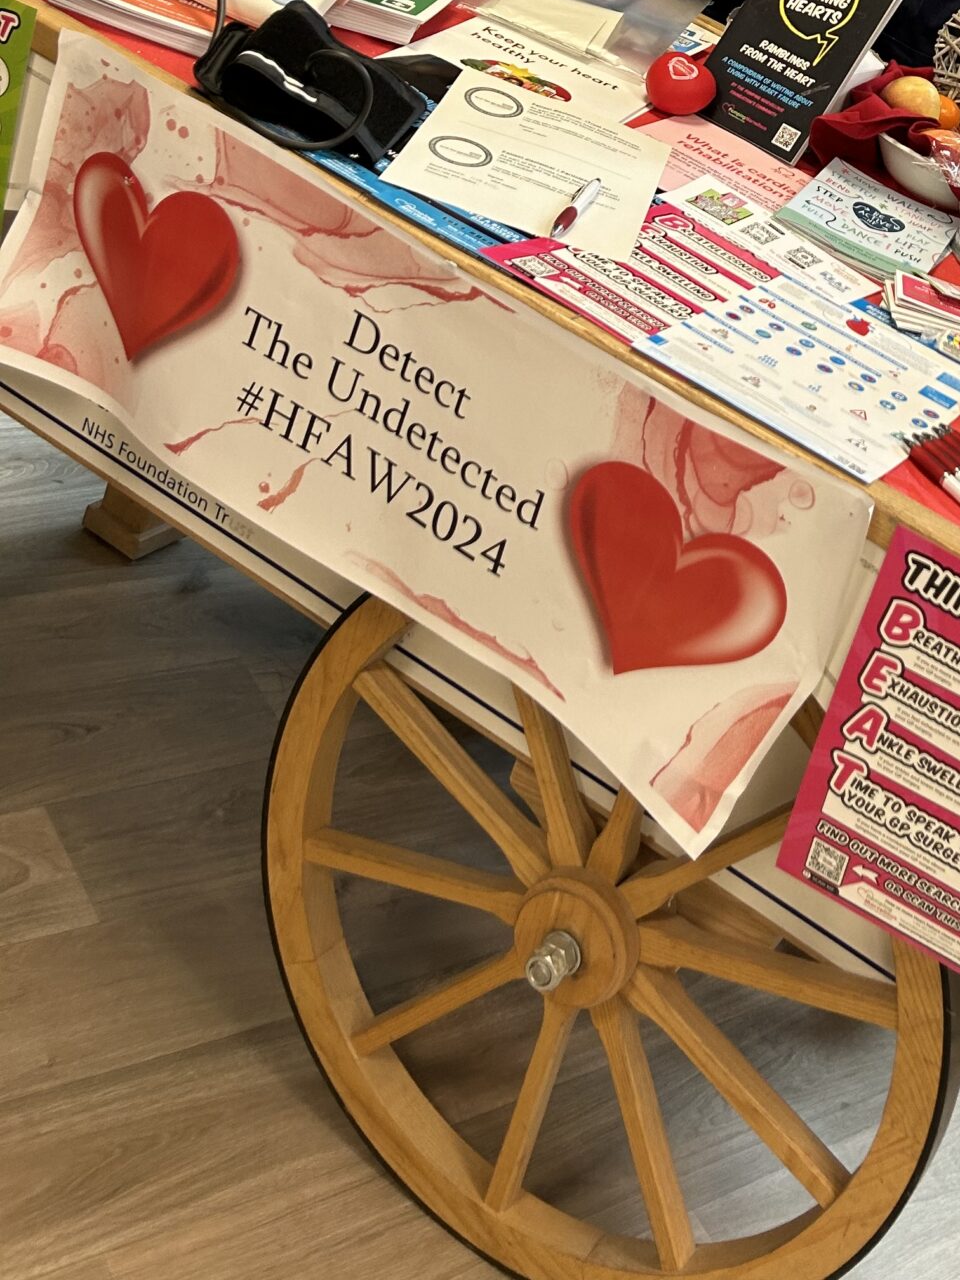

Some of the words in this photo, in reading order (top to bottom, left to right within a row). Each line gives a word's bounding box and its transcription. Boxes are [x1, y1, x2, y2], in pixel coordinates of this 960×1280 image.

[469, 29, 537, 67] healthy
[480, 23, 527, 53] Keep
[527, 47, 571, 71] your
[569, 65, 620, 92] heart
[738, 43, 768, 64] FROM
[765, 58, 786, 75] THE
[784, 66, 816, 89] HEART
[758, 38, 812, 72] RAMBLINGS
[720, 54, 729, 63] A
[726, 57, 764, 82] COMPENDIUM
[762, 75, 773, 85] OF
[770, 79, 796, 98] WRITING
[793, 91, 814, 108] ABOUT
[725, 66, 746, 81] LIVING
[743, 74, 761, 88] WITH
[758, 82, 778, 97] HEART
[776, 91, 801, 109] FAILURE
[675, 137, 794, 203] rehabilitation?
[684, 131, 730, 159] What
[731, 156, 745, 168] is
[746, 166, 799, 197] cardia
[829, 170, 878, 201] STRETCH
[800, 202, 826, 220] PULL
[810, 193, 850, 218] MOVE
[814, 184, 845, 204] STEP
[853, 175, 881, 194] MOVE
[885, 192, 926, 215] WALK
[657, 210, 770, 283] BREATHLESSNESS
[839, 221, 884, 248] DANCE
[893, 235, 930, 256] LIFT
[893, 247, 922, 264] PUSH
[905, 232, 930, 247] PLAY
[577, 252, 611, 276] YOUR
[612, 273, 629, 287] GP
[631, 284, 690, 322] SURGERY
[612, 264, 629, 278] TO
[634, 278, 668, 303] SPEAK
[673, 302, 689, 315] TO
[655, 263, 714, 302] SWELLING
[336, 307, 481, 421] Detect
[229, 305, 325, 384] The
[314, 355, 556, 533] Undetected
[78, 416, 119, 452] NHS
[114, 440, 213, 513] Foundation
[228, 375, 520, 580] #HFAW2024
[842, 701, 915, 763] ANKLE
[822, 751, 883, 802] TIME
[881, 794, 904, 814] TO
[903, 808, 956, 845] SPEAK
[843, 789, 886, 822] YOUR
[886, 815, 912, 836] GP
[817, 820, 850, 846] FIND
[848, 839, 877, 862] OUT
[877, 855, 917, 885] MORE
[883, 879, 903, 897] OR
[902, 890, 936, 916] SCAN
